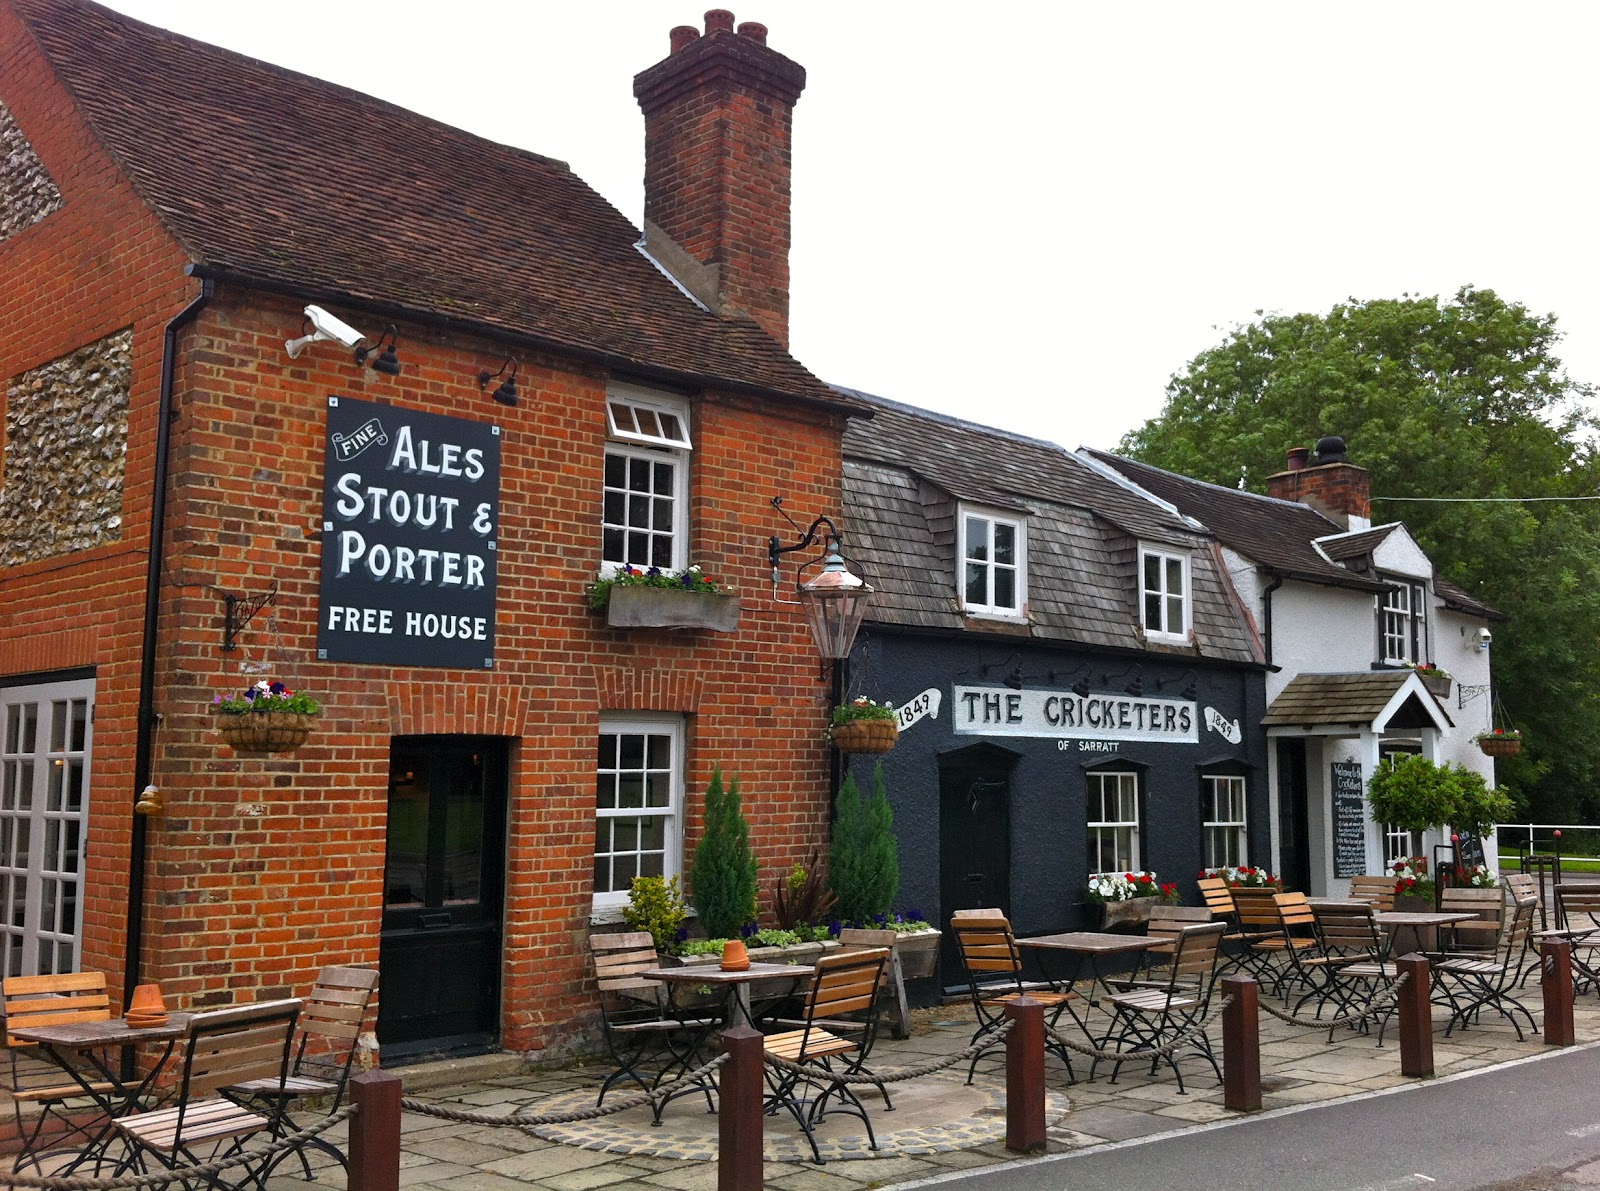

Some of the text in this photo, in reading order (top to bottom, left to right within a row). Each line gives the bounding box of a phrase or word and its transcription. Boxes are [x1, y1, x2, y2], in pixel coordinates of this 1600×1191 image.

[341, 424, 485, 481] FINE ALES
[334, 472, 493, 536] STOUT &
[338, 530, 485, 588] PORTER
[328, 605, 487, 641] FREE HOUSE
[899, 694, 929, 727] 1849
[961, 691, 1191, 733] THE CRICKETERS
[1211, 711, 1232, 738] 1849
[1057, 740, 1120, 752] OF SARRATT
